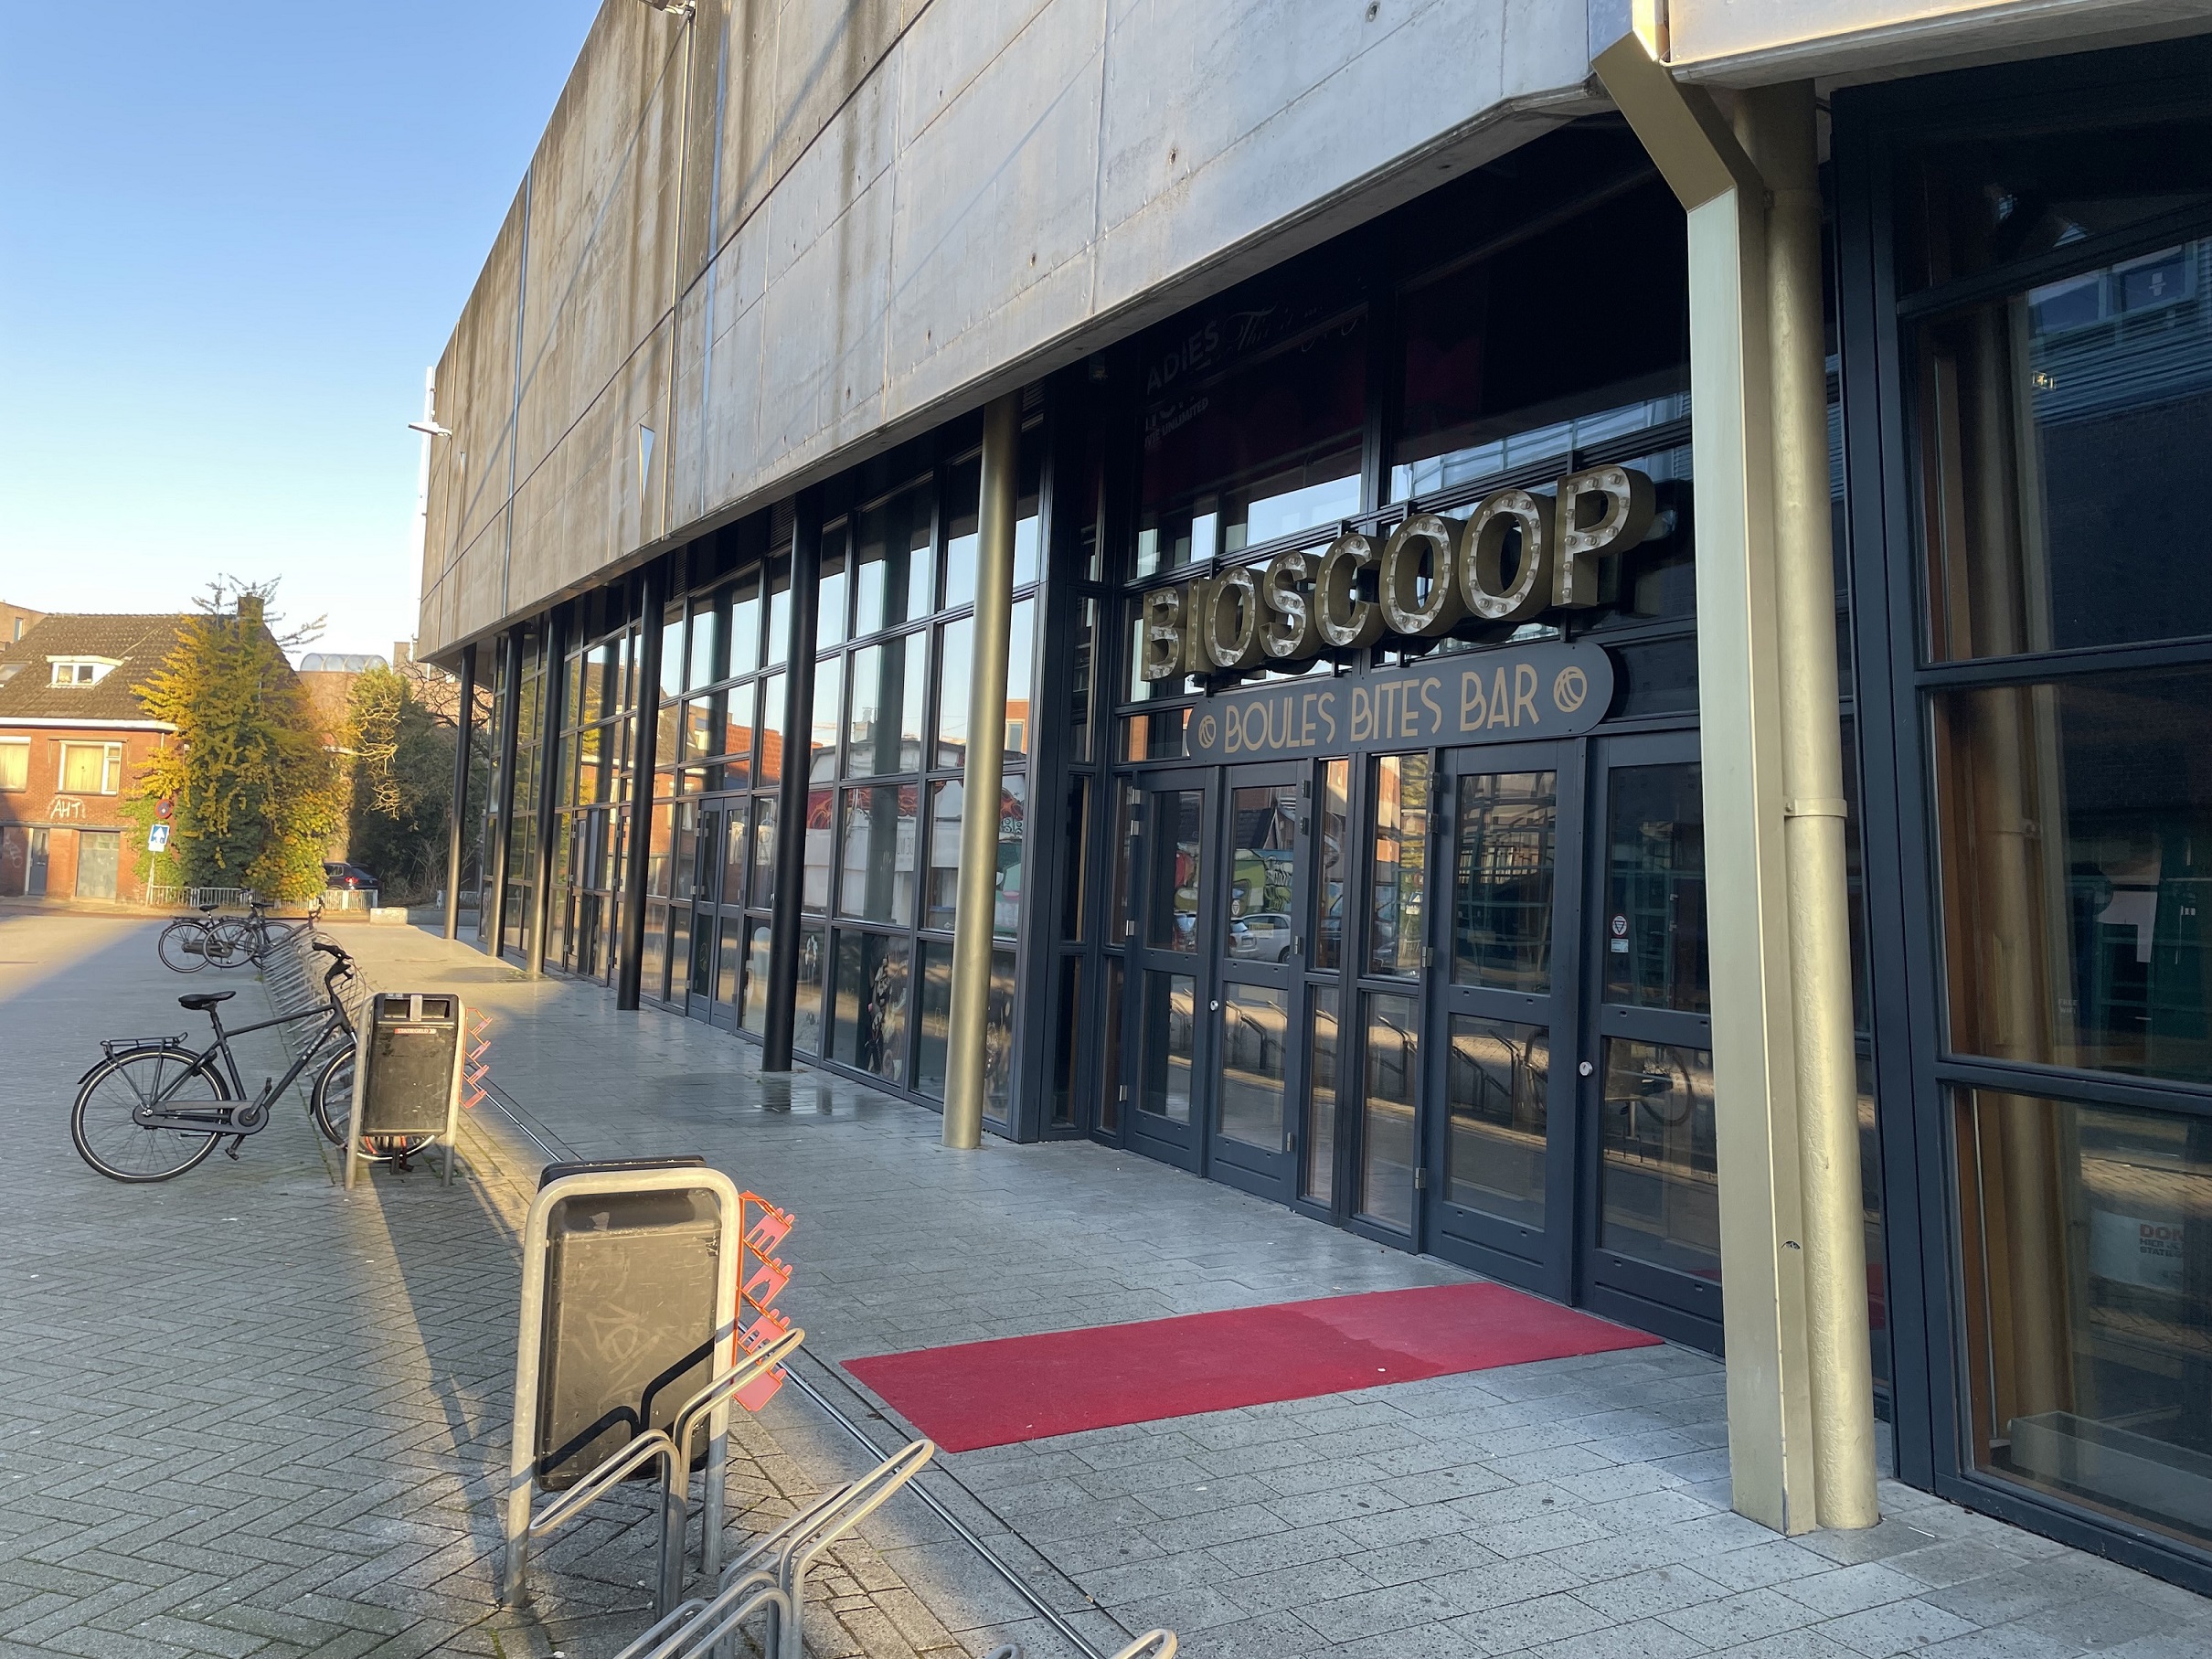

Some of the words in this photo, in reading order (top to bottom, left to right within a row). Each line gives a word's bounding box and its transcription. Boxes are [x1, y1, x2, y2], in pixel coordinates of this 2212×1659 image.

[1162, 396, 1210, 437] UNLIMITED
[1141, 464, 1655, 682] BIOSCOOP
[1225, 692, 1336, 753] BOULES
[1350, 676, 1442, 742] BITES
[1461, 664, 1540, 732] BAR
[2140, 1239, 2164, 1248] HIER
